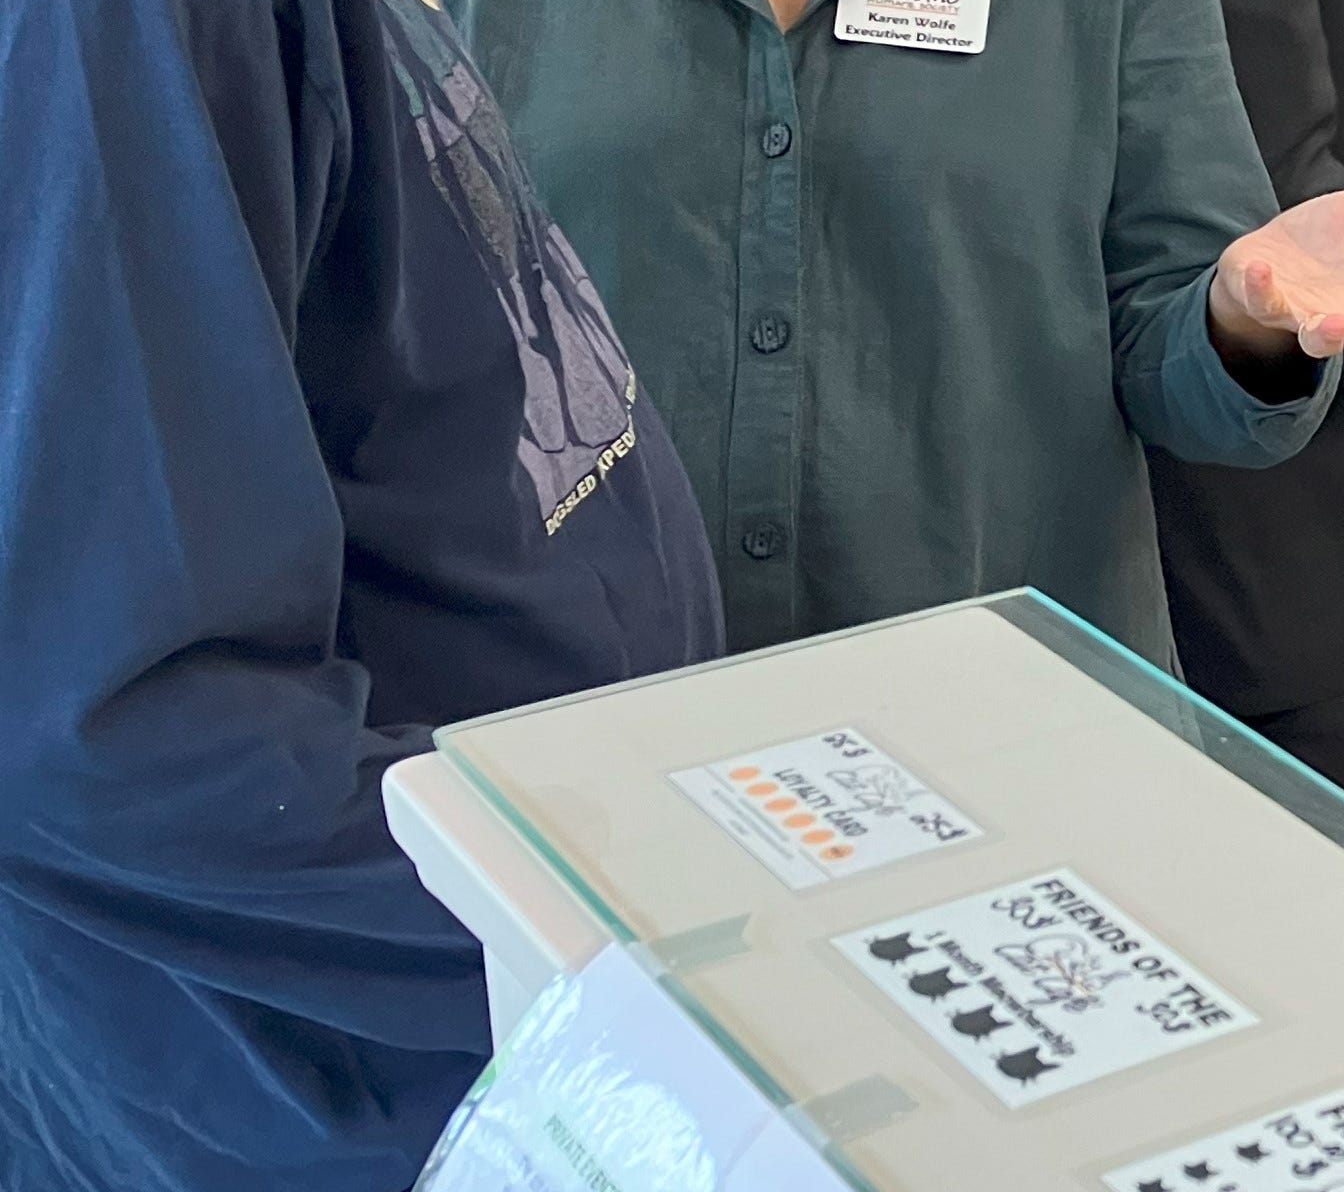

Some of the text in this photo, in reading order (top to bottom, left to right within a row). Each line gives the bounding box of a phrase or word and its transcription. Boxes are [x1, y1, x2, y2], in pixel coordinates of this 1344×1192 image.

[844, 24, 974, 48] Executive Director
[868, 11, 957, 31] Karen Wolfe
[773, 767, 838, 809] LOYALTY
[822, 807, 870, 838] CARD
[1031, 877, 1234, 1030] FRIENDS OF THE
[939, 938, 986, 979] Month
[979, 975, 1076, 1057] Membership
